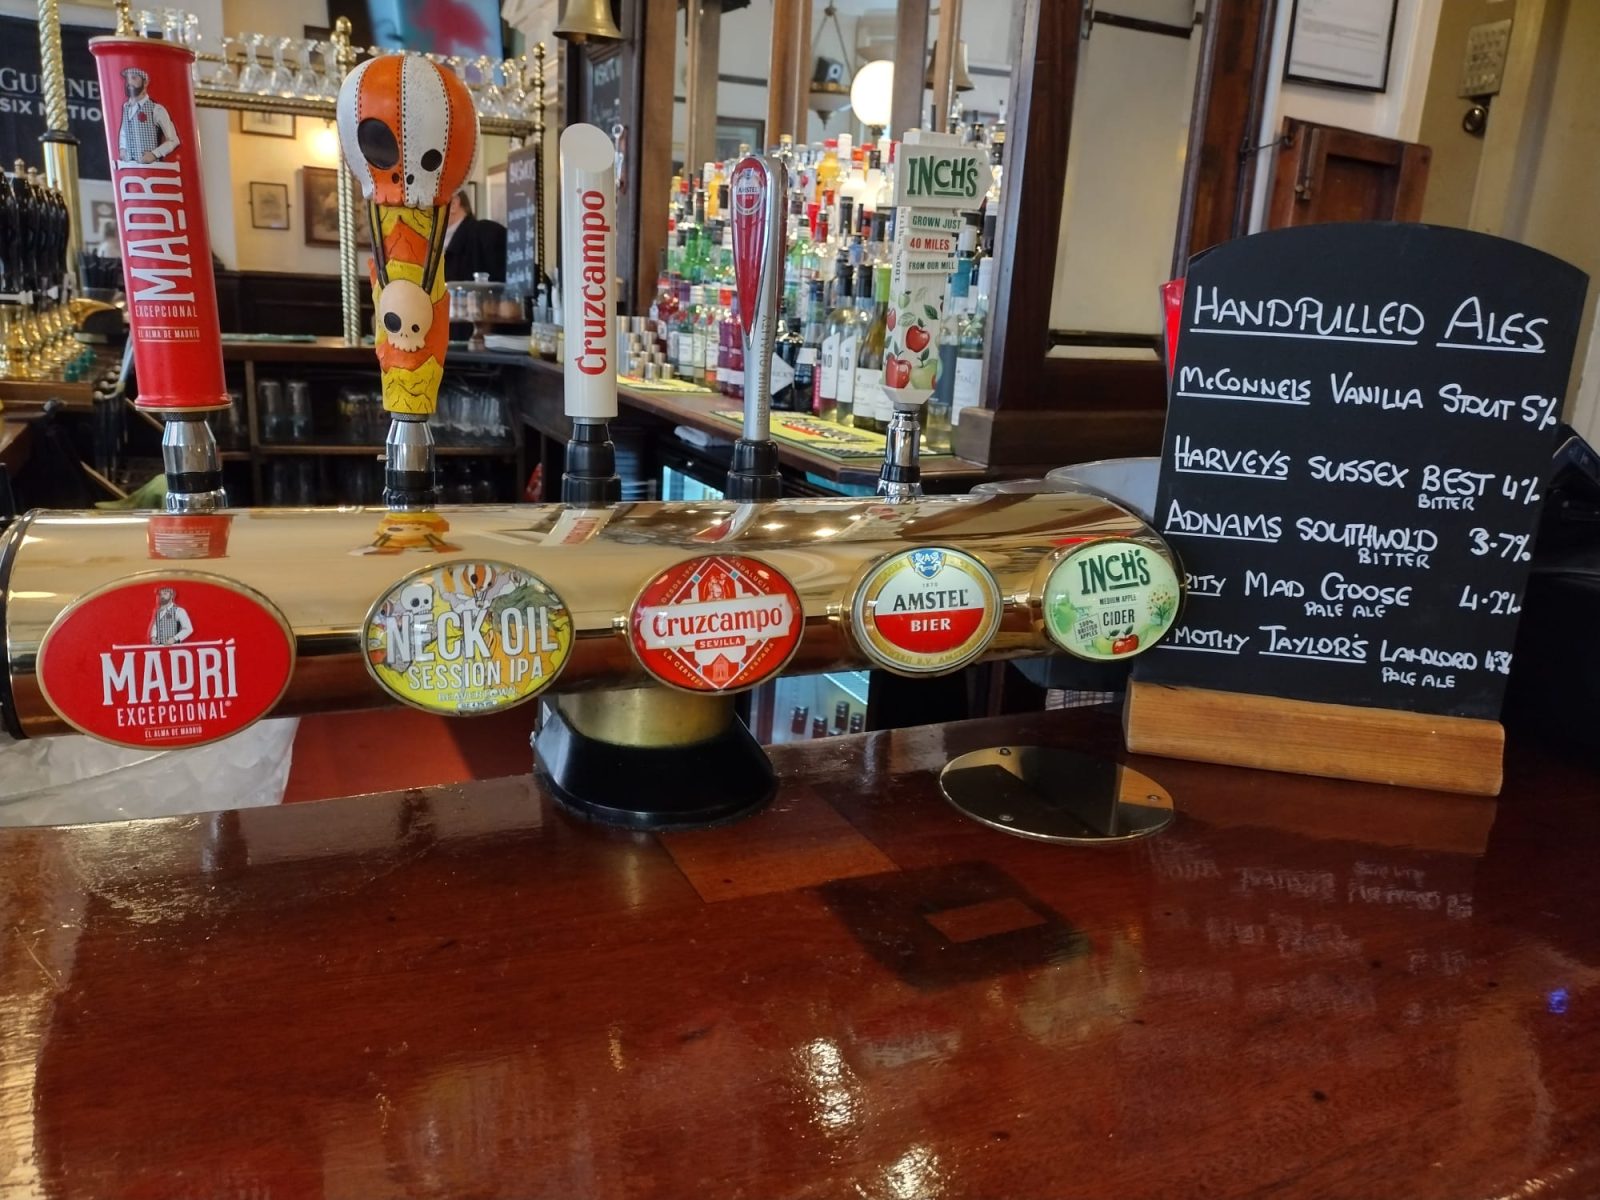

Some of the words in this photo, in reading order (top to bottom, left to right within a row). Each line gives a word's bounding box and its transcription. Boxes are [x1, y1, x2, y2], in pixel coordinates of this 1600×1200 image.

[0, 97, 32, 115] SIX
[912, 216, 940, 228] GROWN
[942, 218, 962, 229] JUST
[910, 238, 921, 248] 40
[924, 238, 950, 250] MILES
[908, 262, 925, 270] FROM
[926, 262, 939, 270] OUR
[941, 261, 955, 270] MILL
[575, 190, 612, 376] Cruzcampo
[135, 305, 198, 318] EXCEPCIONAL
[1194, 285, 1425, 335] HANDPULLED
[1444, 296, 1548, 350] ALES
[145, 329, 162, 338] ALMA
[164, 330, 172, 338] DE
[174, 330, 200, 338] MADRID
[1331, 372, 1423, 410] VANILLA
[1439, 383, 1516, 420] STOUT
[1521, 395, 1557, 430] 5%
[1308, 456, 1409, 488] SUSSEX
[1422, 465, 1496, 496] BEST
[1502, 475, 1540, 505] 4%
[1418, 493, 1475, 511] BITTER
[1165, 499, 1282, 539] ADNAMS
[1296, 517, 1438, 553] SOUTHWOLD
[1358, 548, 1430, 569] BITTER
[660, 580, 682, 603] DESDE
[1245, 569, 1305, 598] MAD
[1321, 572, 1413, 606] GOOSE
[893, 589, 969, 612] AMSTEL
[1100, 596, 1120, 605] MEDIUM
[1122, 594, 1137, 603] APPLE
[1304, 601, 1344, 617] PALE
[1352, 604, 1386, 618] ALE
[652, 607, 783, 638] Cruzcampo
[911, 618, 951, 632] BIER
[1103, 609, 1136, 626] CIDER
[386, 608, 492, 665] NECK
[502, 606, 559, 656] OIL
[700, 637, 741, 648] SEVILLA
[663, 651, 673, 661] LA
[1166, 626, 1250, 652] MOTHY
[1259, 625, 1369, 659] TAYLOR'S
[1380, 640, 1478, 671] LANDLORD
[100, 638, 238, 706] MADRÍ
[408, 660, 501, 690] SESSION
[510, 656, 544, 684] IPA
[1382, 666, 1416, 686] PALE
[1421, 675, 1456, 688] ALE
[117, 701, 227, 727] EXCEPCIONAL
[145, 730, 152, 738] EL
[154, 729, 170, 738] ALMA
[172, 728, 179, 736] DE
[180, 726, 202, 736] MADRID
